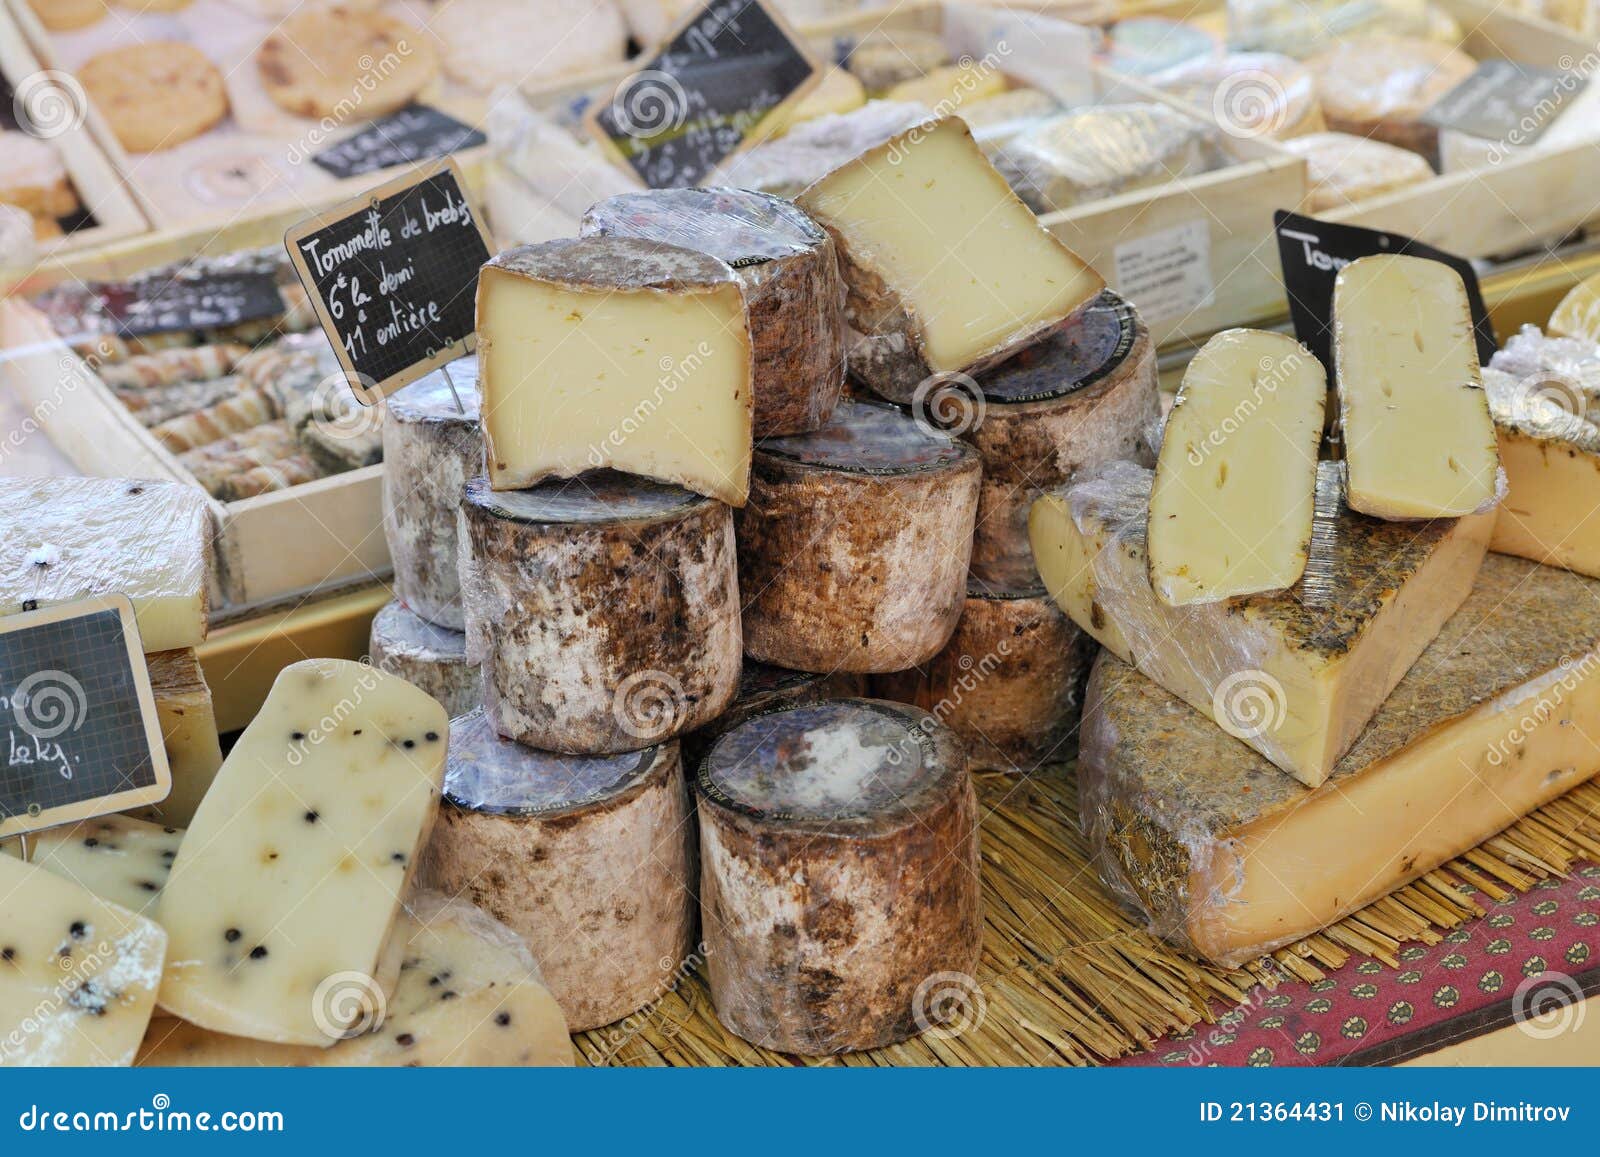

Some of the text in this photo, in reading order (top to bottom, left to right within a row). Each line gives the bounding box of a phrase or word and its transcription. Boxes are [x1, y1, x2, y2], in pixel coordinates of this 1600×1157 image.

[301, 211, 392, 277] Tommette
[401, 205, 422, 238] de
[351, 277, 372, 307] la
[378, 257, 415, 296] demi
[376, 300, 441, 346] entière
